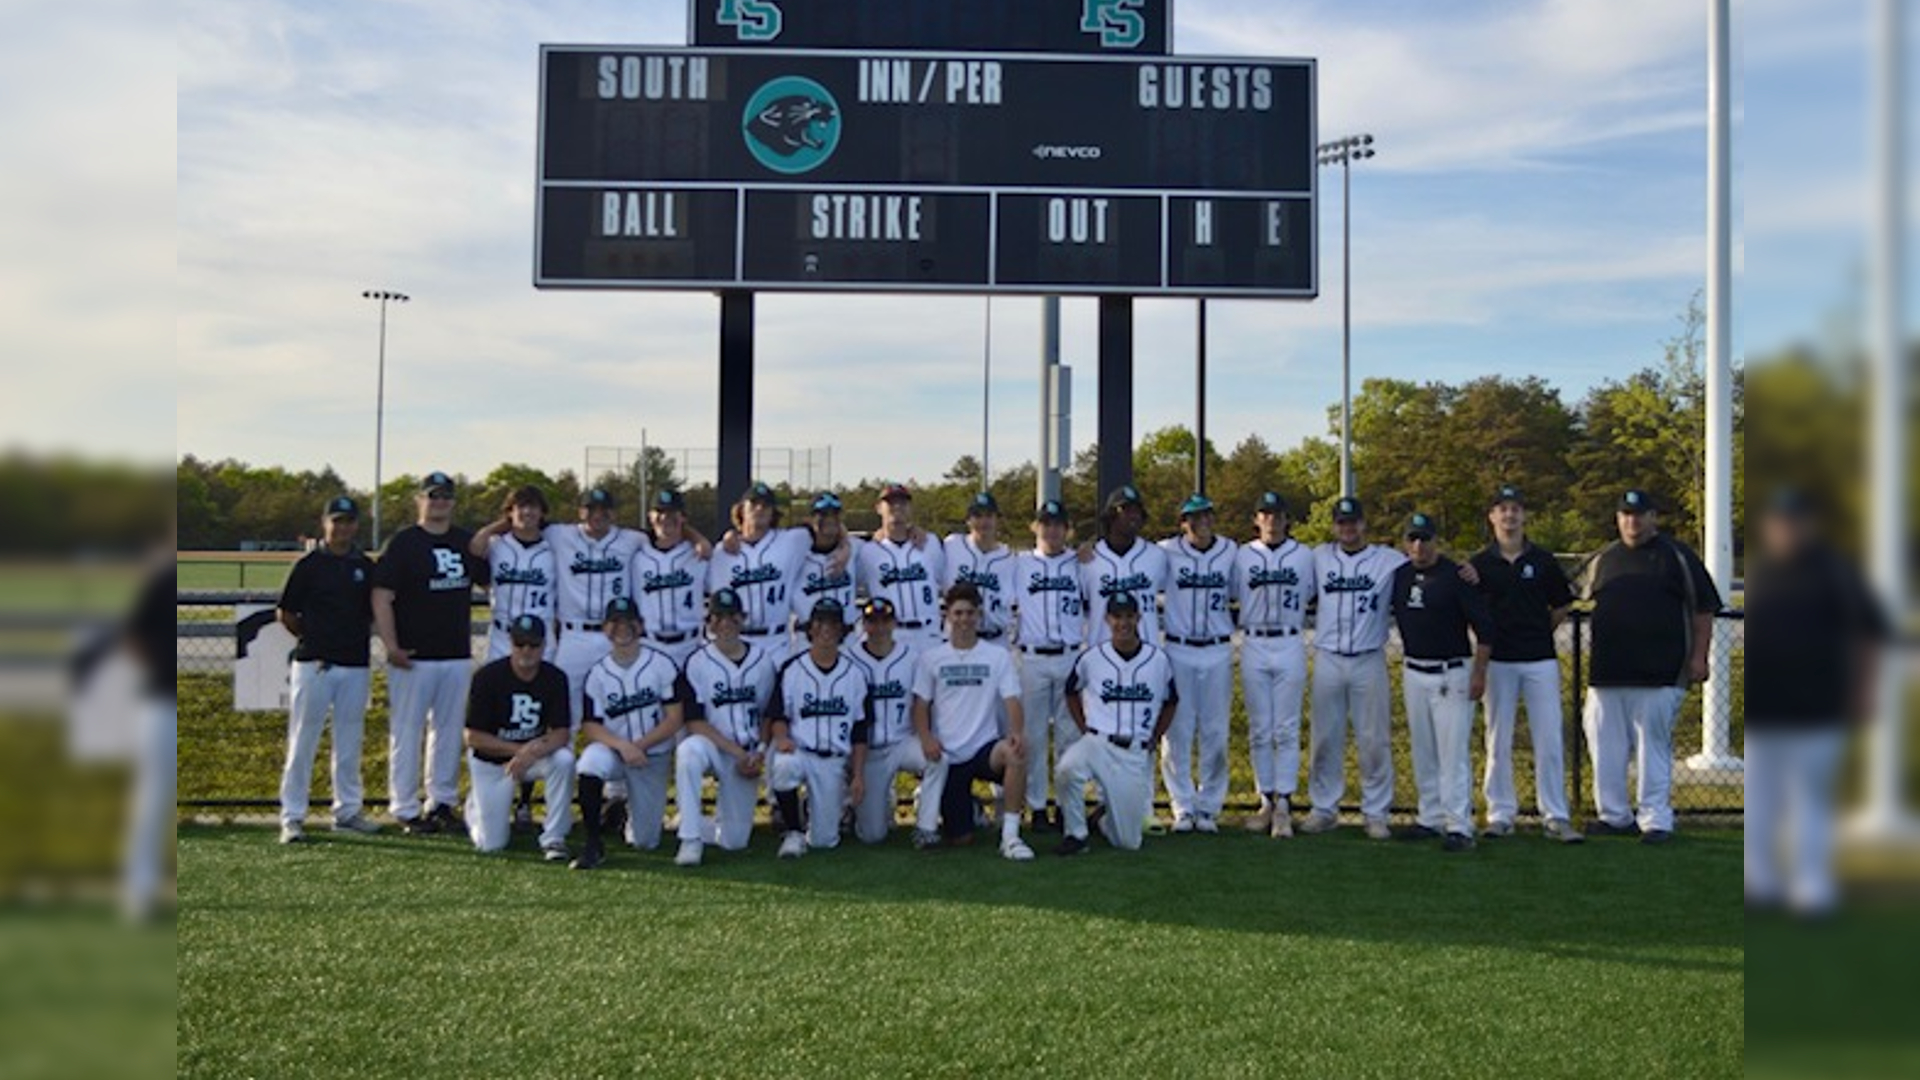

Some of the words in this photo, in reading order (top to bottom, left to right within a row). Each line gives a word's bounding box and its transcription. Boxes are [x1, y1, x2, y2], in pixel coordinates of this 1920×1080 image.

[597, 56, 709, 100] SOUTH
[858, 59, 911, 103] INN
[945, 61, 1002, 105] PER
[1138, 64, 1273, 110] GUESTS
[602, 192, 677, 237] BALL
[811, 195, 921, 240] STRIKE
[1048, 198, 1108, 244] OUT
[1194, 201, 1212, 246] H
[1267, 201, 1281, 246] E
[432, 548, 464, 579] PS
[611, 577, 623, 596] 6
[683, 591, 694, 610] 4
[922, 585, 933, 606] 8
[510, 693, 542, 729] PS
[839, 722, 849, 742] 3
[1141, 708, 1152, 729] 2
